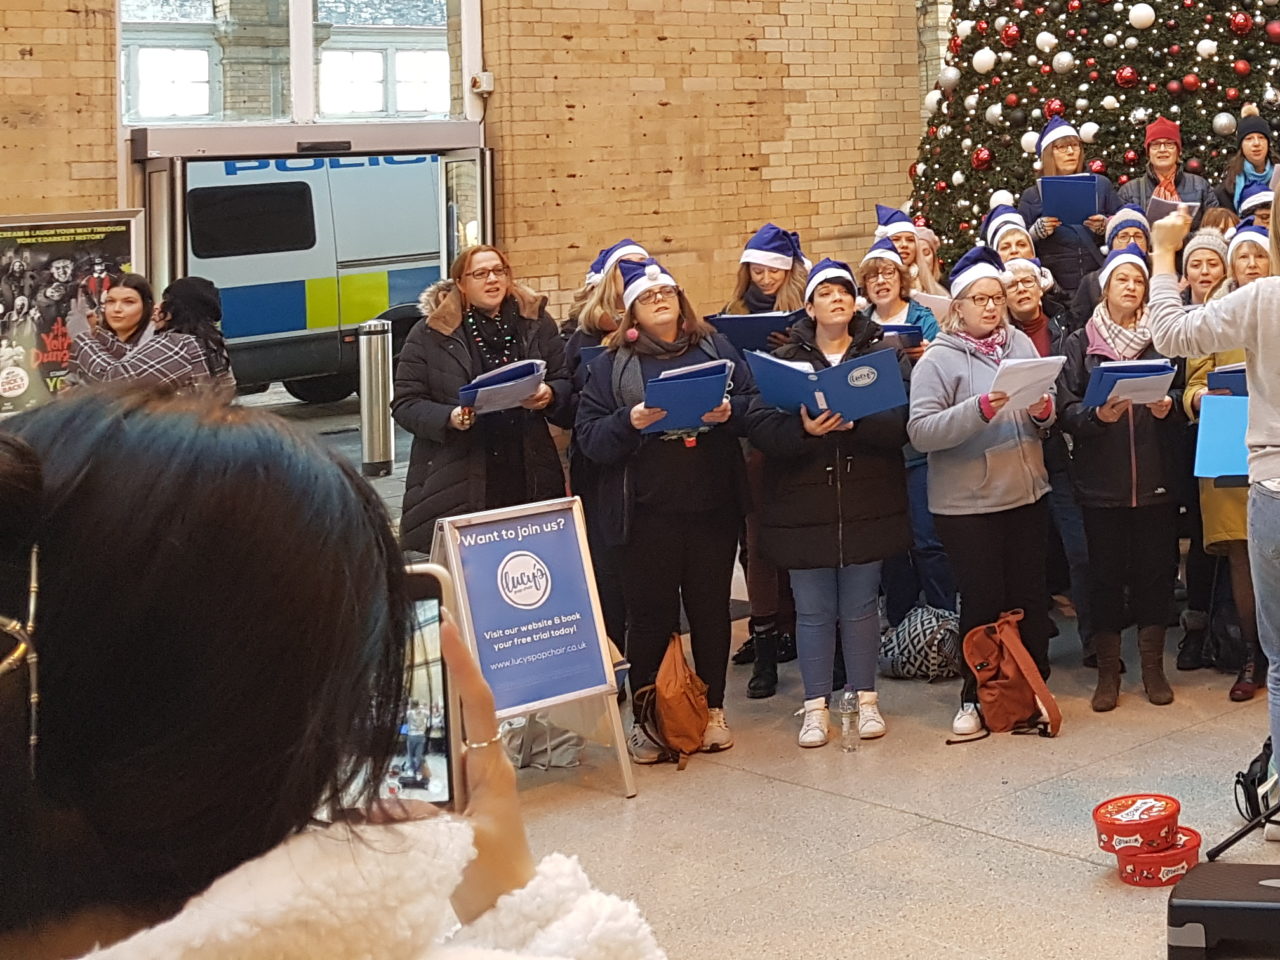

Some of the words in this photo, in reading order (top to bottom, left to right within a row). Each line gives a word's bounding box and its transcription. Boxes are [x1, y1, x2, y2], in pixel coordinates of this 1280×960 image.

[224, 154, 438, 176] POLIC
[0, 230, 24, 238] CREAM
[31, 346, 69, 369] Dung
[461, 530, 500, 547] Want
[501, 529, 515, 540] to
[517, 523, 541, 541] join
[543, 518, 565, 532] us?
[504, 563, 546, 593] lucy's
[483, 629, 503, 640] Visit
[504, 627, 519, 636] our
[520, 619, 552, 632] website
[561, 612, 581, 623] book
[493, 640, 513, 652] your
[514, 636, 532, 646] free
[533, 630, 550, 641] trial
[551, 624, 577, 638] today!
